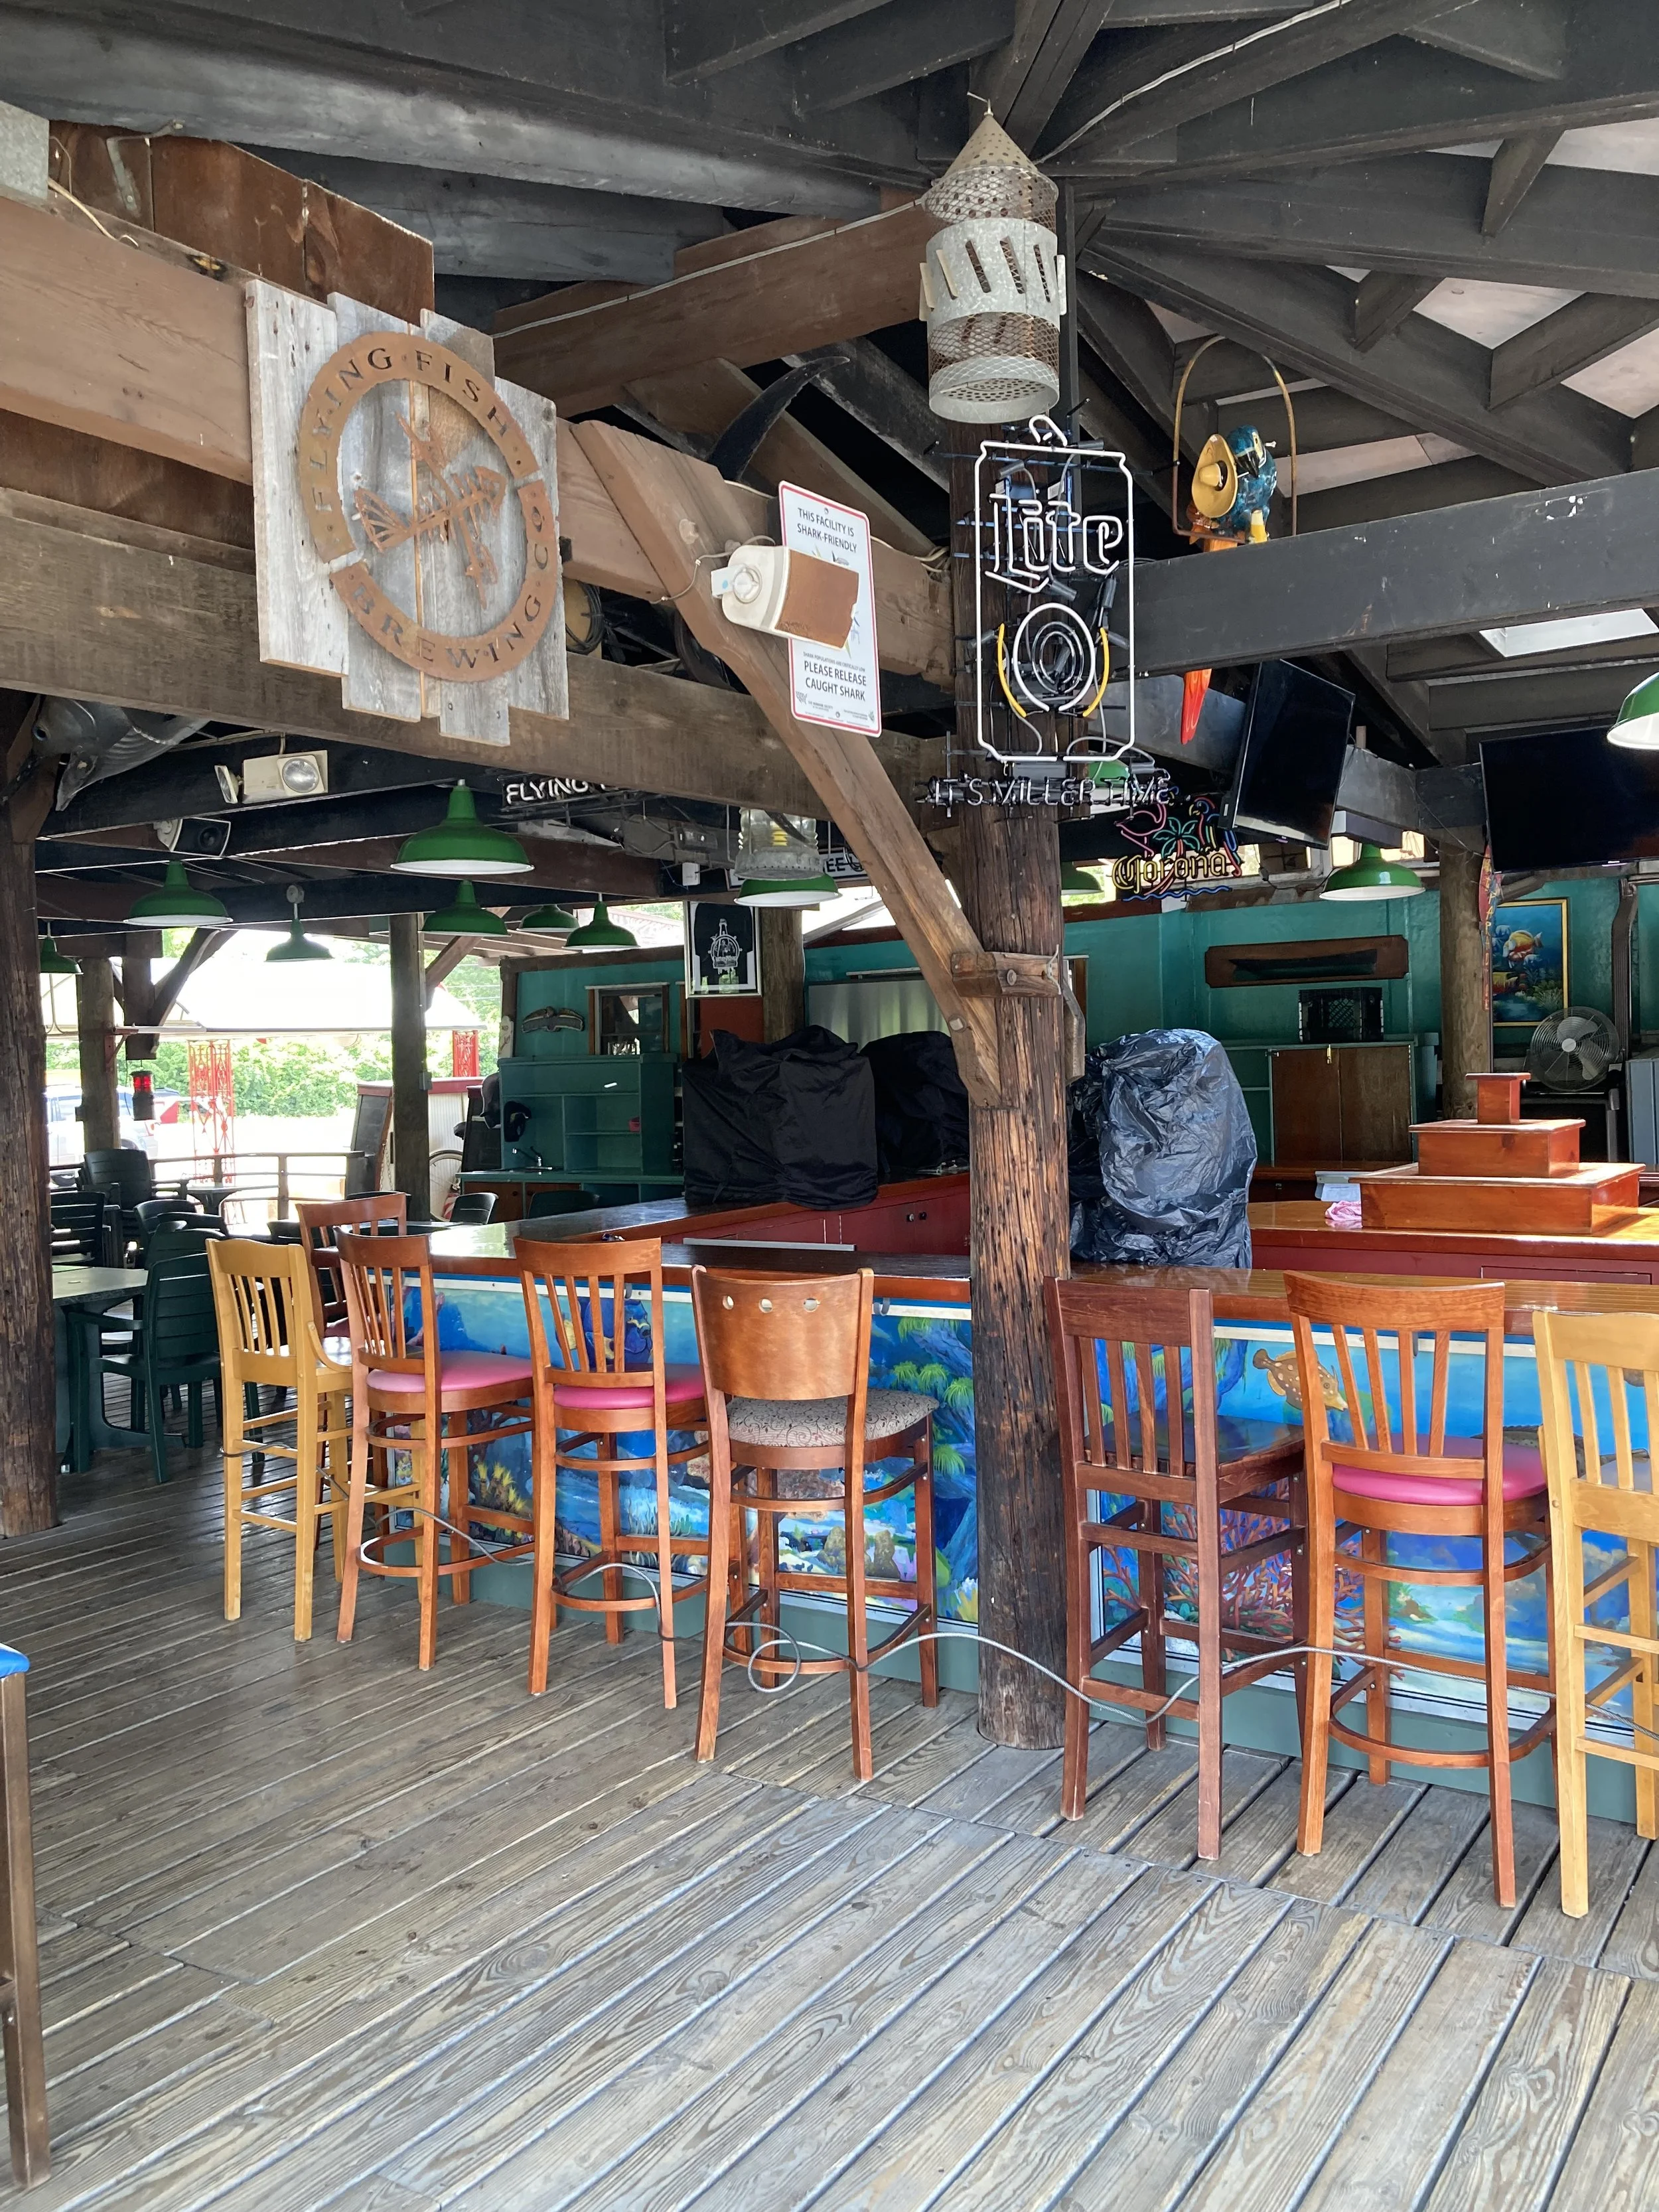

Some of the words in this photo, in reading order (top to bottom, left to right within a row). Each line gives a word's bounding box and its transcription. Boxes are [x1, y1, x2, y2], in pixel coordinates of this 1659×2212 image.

[311, 347, 392, 512] FLYING
[415, 348, 508, 438] FISH
[798, 508, 815, 522] THIS
[816, 515, 846, 534] FACILITY
[847, 526, 854, 537] IS
[797, 523, 857, 553] SHARK-FRIENDLY
[985, 492, 1123, 593] Lite
[352, 586, 541, 669] BREWING
[804, 661, 833, 678] PLEASE
[835, 670, 867, 686] RELEASE
[806, 677, 838, 694] CAUGHT
[840, 686, 865, 701] SHARK
[506, 778, 589, 804] FLYING
[1112, 851, 1229, 894] Corona
